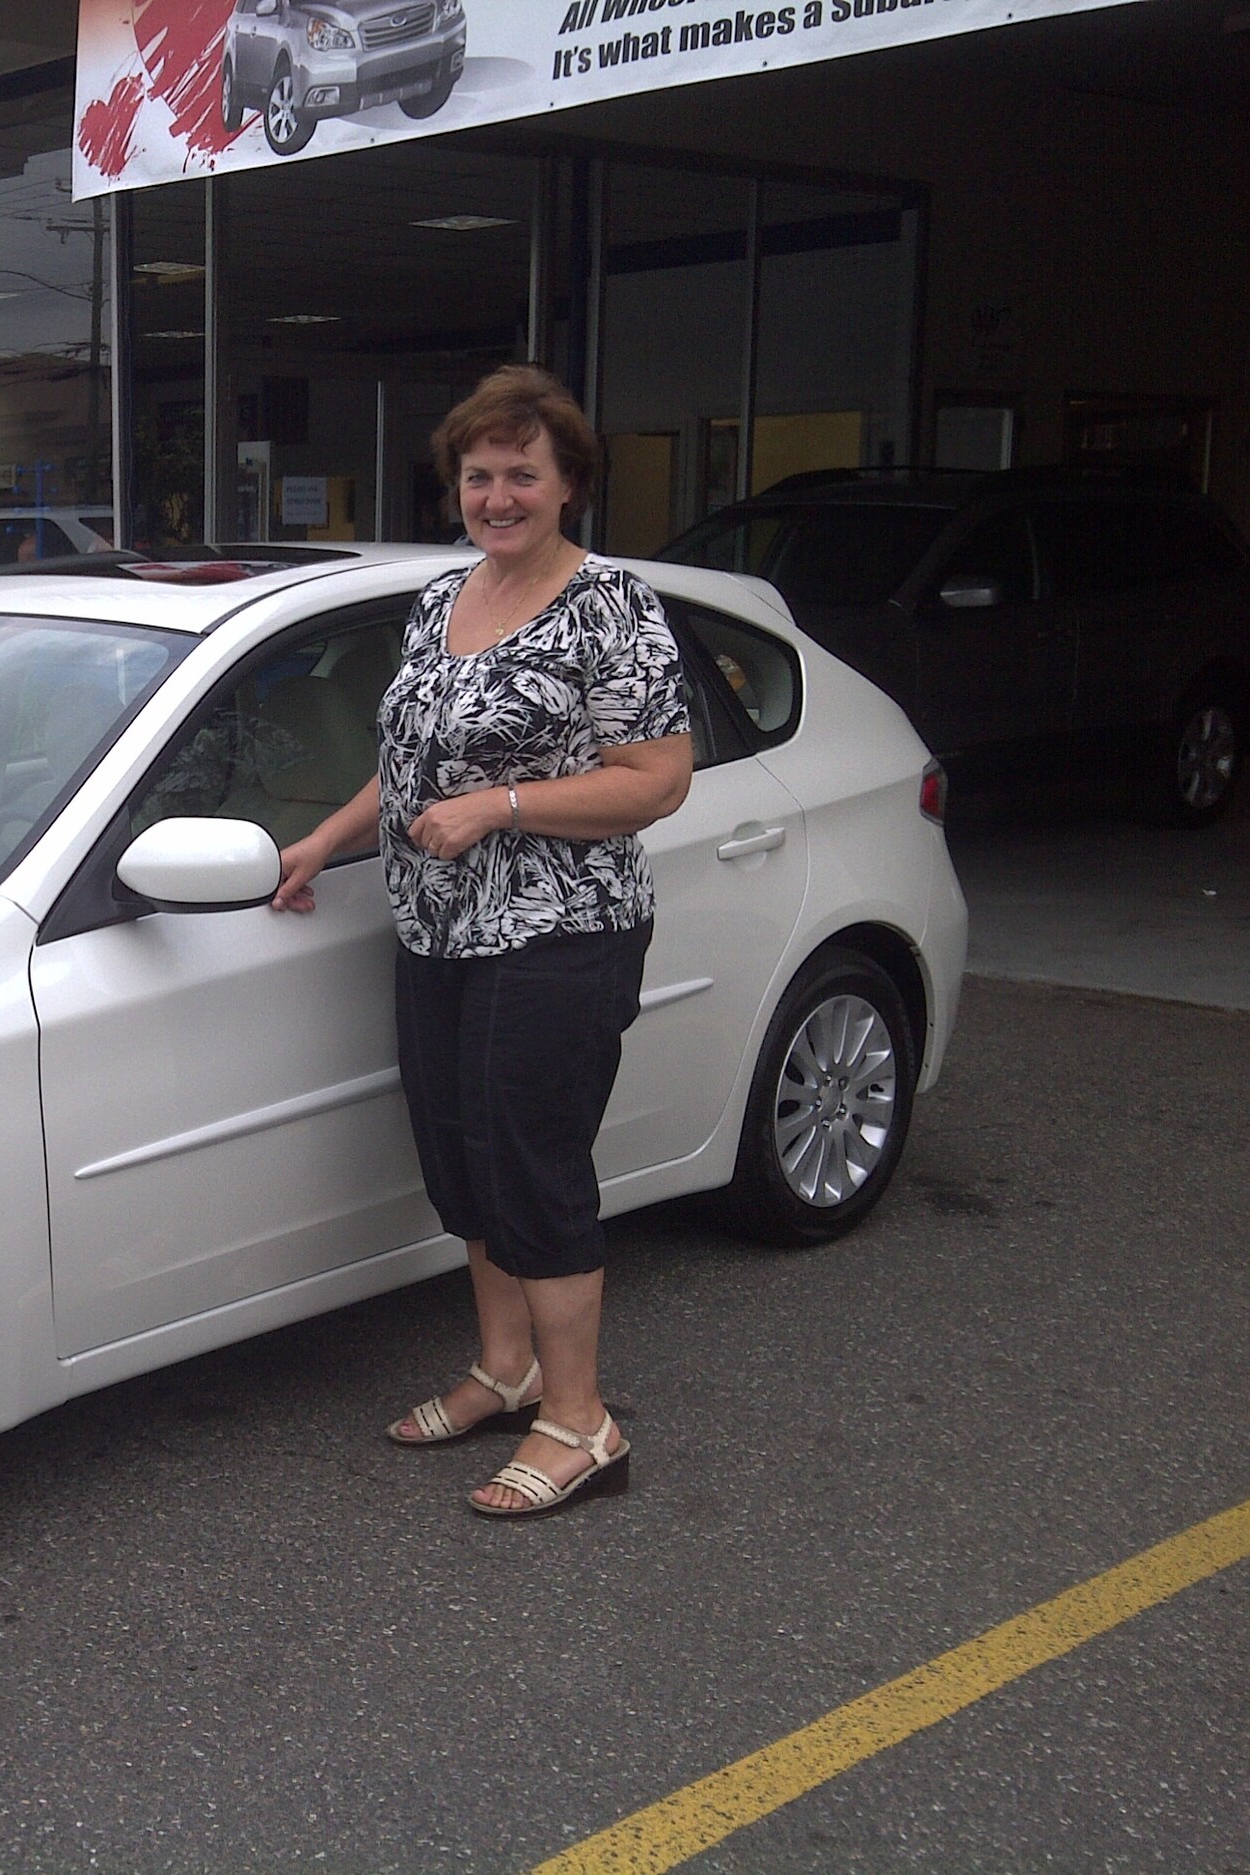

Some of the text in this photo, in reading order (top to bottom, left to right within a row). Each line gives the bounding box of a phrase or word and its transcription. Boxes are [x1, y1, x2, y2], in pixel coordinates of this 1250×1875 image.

[553, 46, 591, 79] It's
[600, 26, 671, 68] what
[679, 7, 795, 51] makes
[803, 1, 822, 29] a
[558, 0, 598, 34] All
